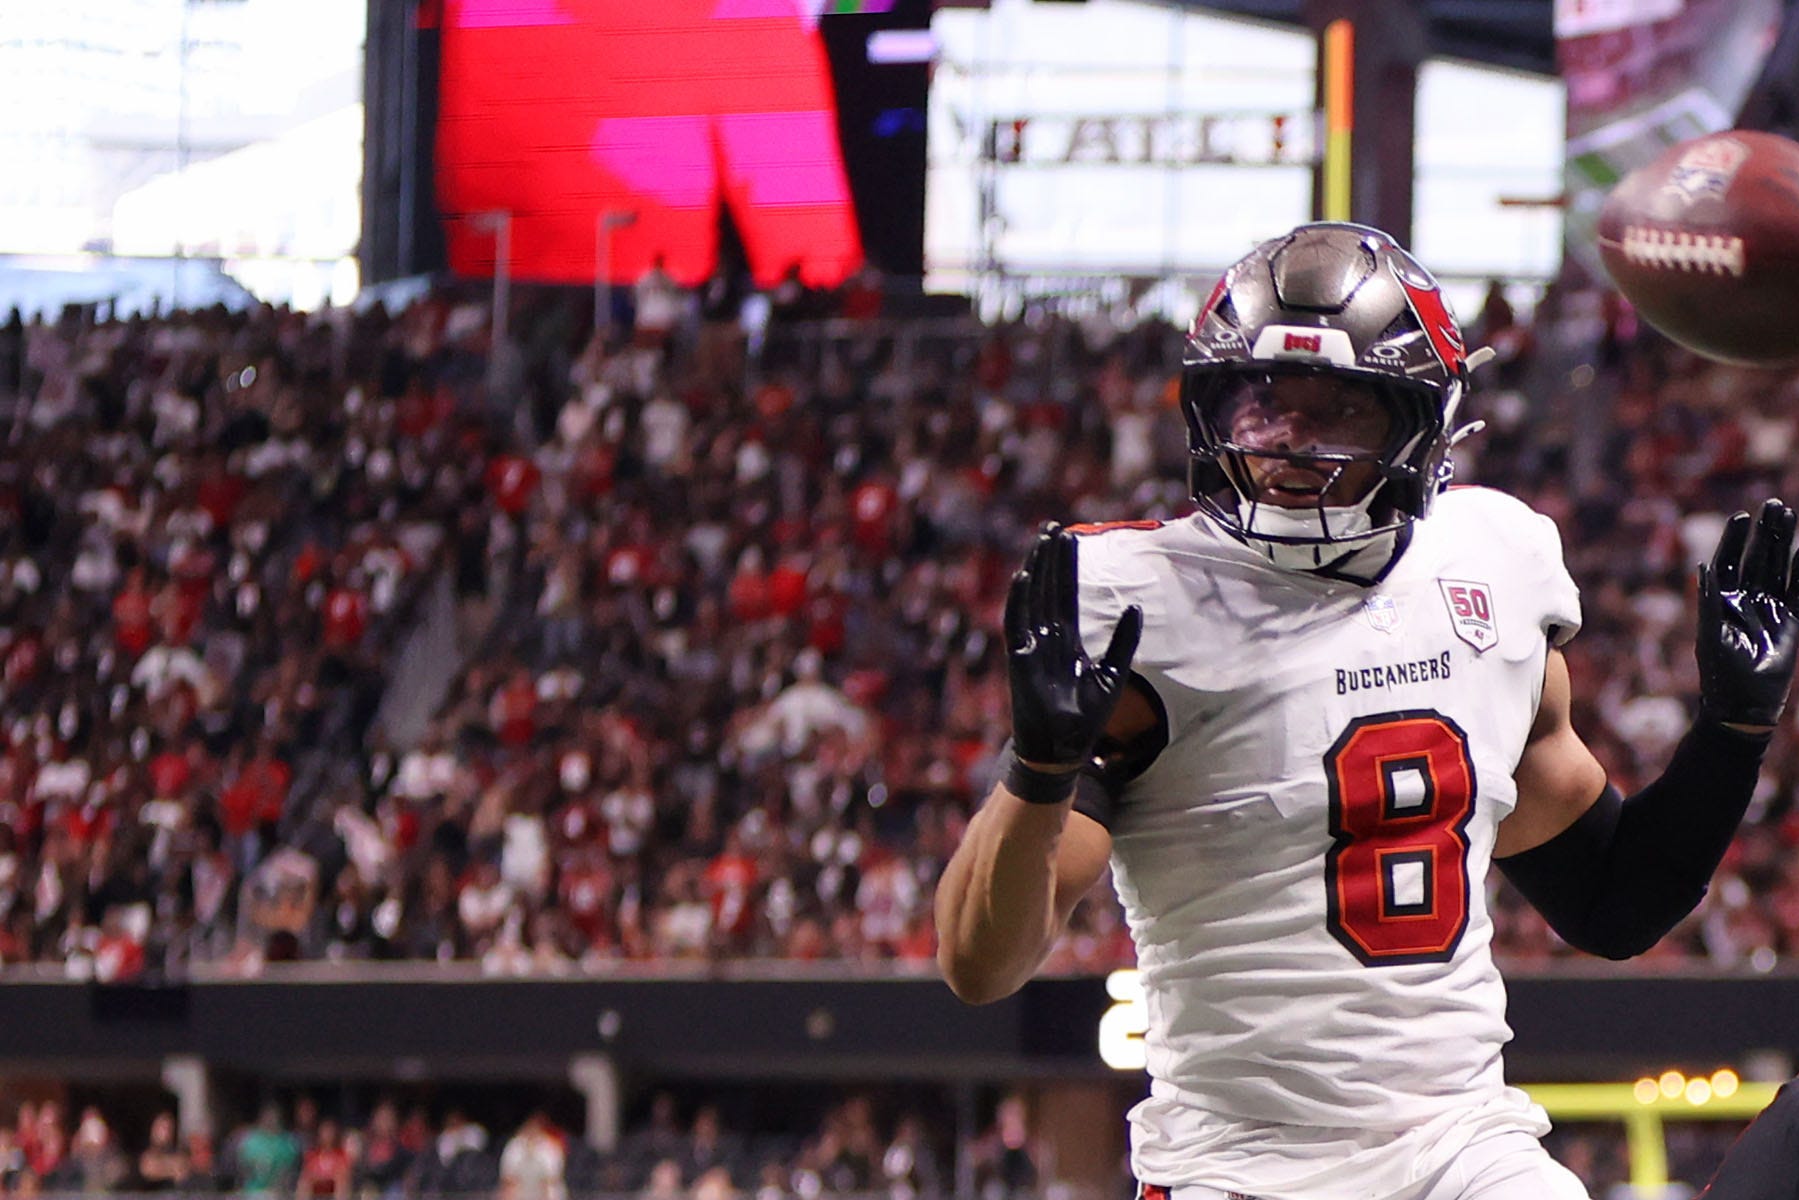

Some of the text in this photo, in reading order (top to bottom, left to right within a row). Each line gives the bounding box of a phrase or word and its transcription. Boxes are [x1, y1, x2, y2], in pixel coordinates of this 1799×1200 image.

[1364, 355, 1406, 367] OAKLEY
[1448, 587, 1490, 622] 50
[1335, 651, 1451, 695] BUCCANEERS
[1323, 708, 1477, 968] 8
